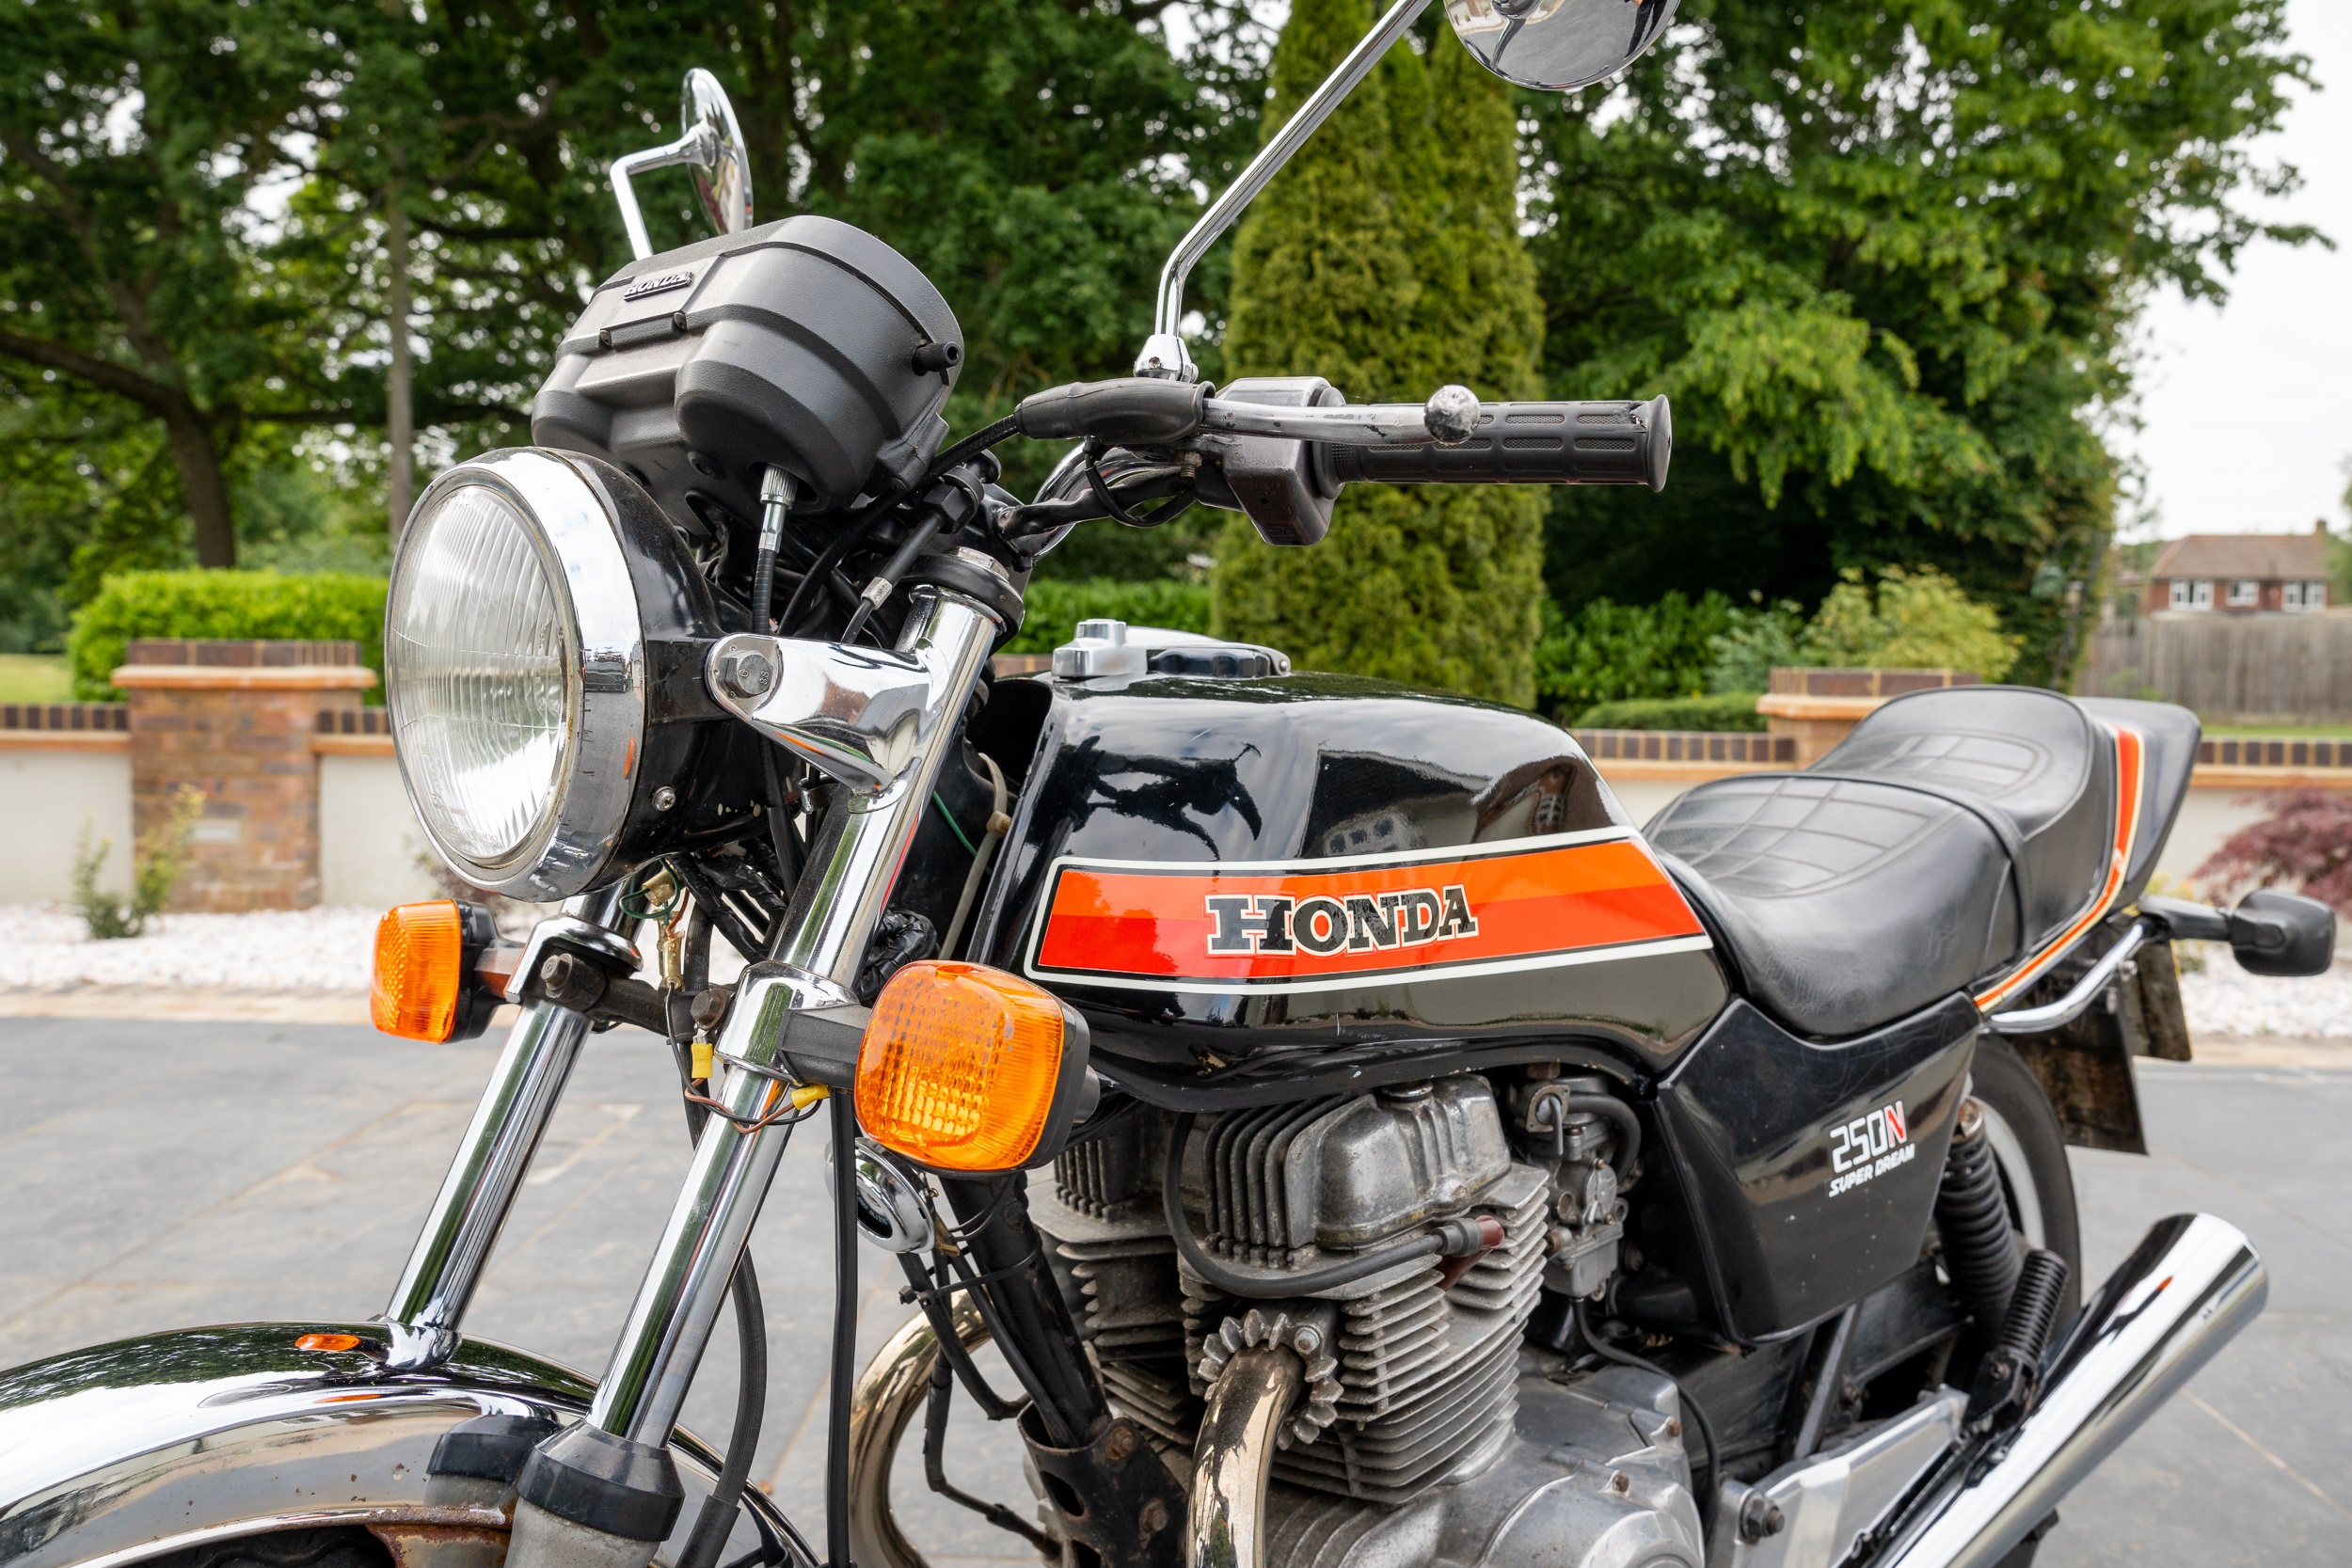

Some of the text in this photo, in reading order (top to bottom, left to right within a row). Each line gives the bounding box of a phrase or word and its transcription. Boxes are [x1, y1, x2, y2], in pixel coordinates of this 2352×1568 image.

[624, 271, 691, 297] HONDA
[1204, 884, 1479, 957] HONDA
[1830, 1100, 1908, 1174] 250N
[1828, 1143, 1915, 1197] SUPER DREAM
